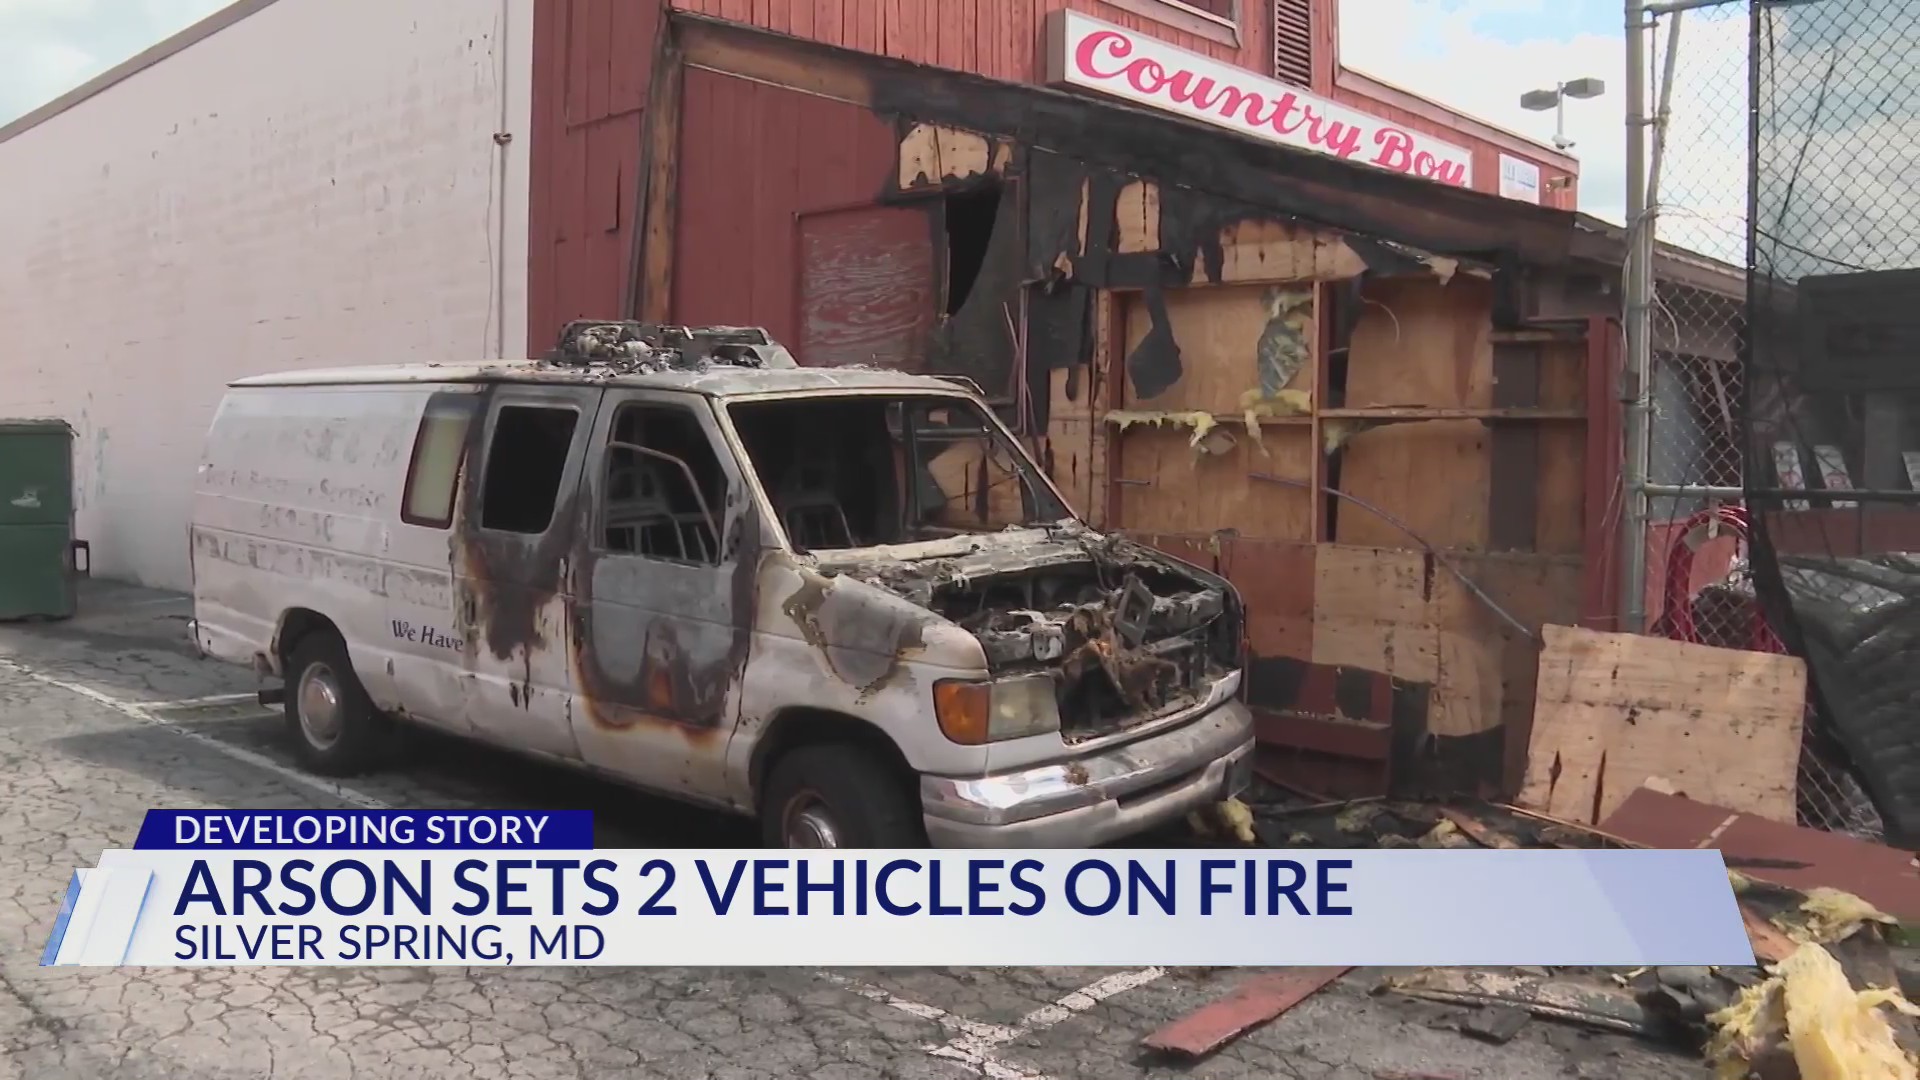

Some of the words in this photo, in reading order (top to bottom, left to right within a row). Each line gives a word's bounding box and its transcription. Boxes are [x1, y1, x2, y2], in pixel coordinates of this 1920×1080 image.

[1075, 31, 1361, 159] Country
[392, 619, 416, 642] We
[421, 625, 465, 653] Have
